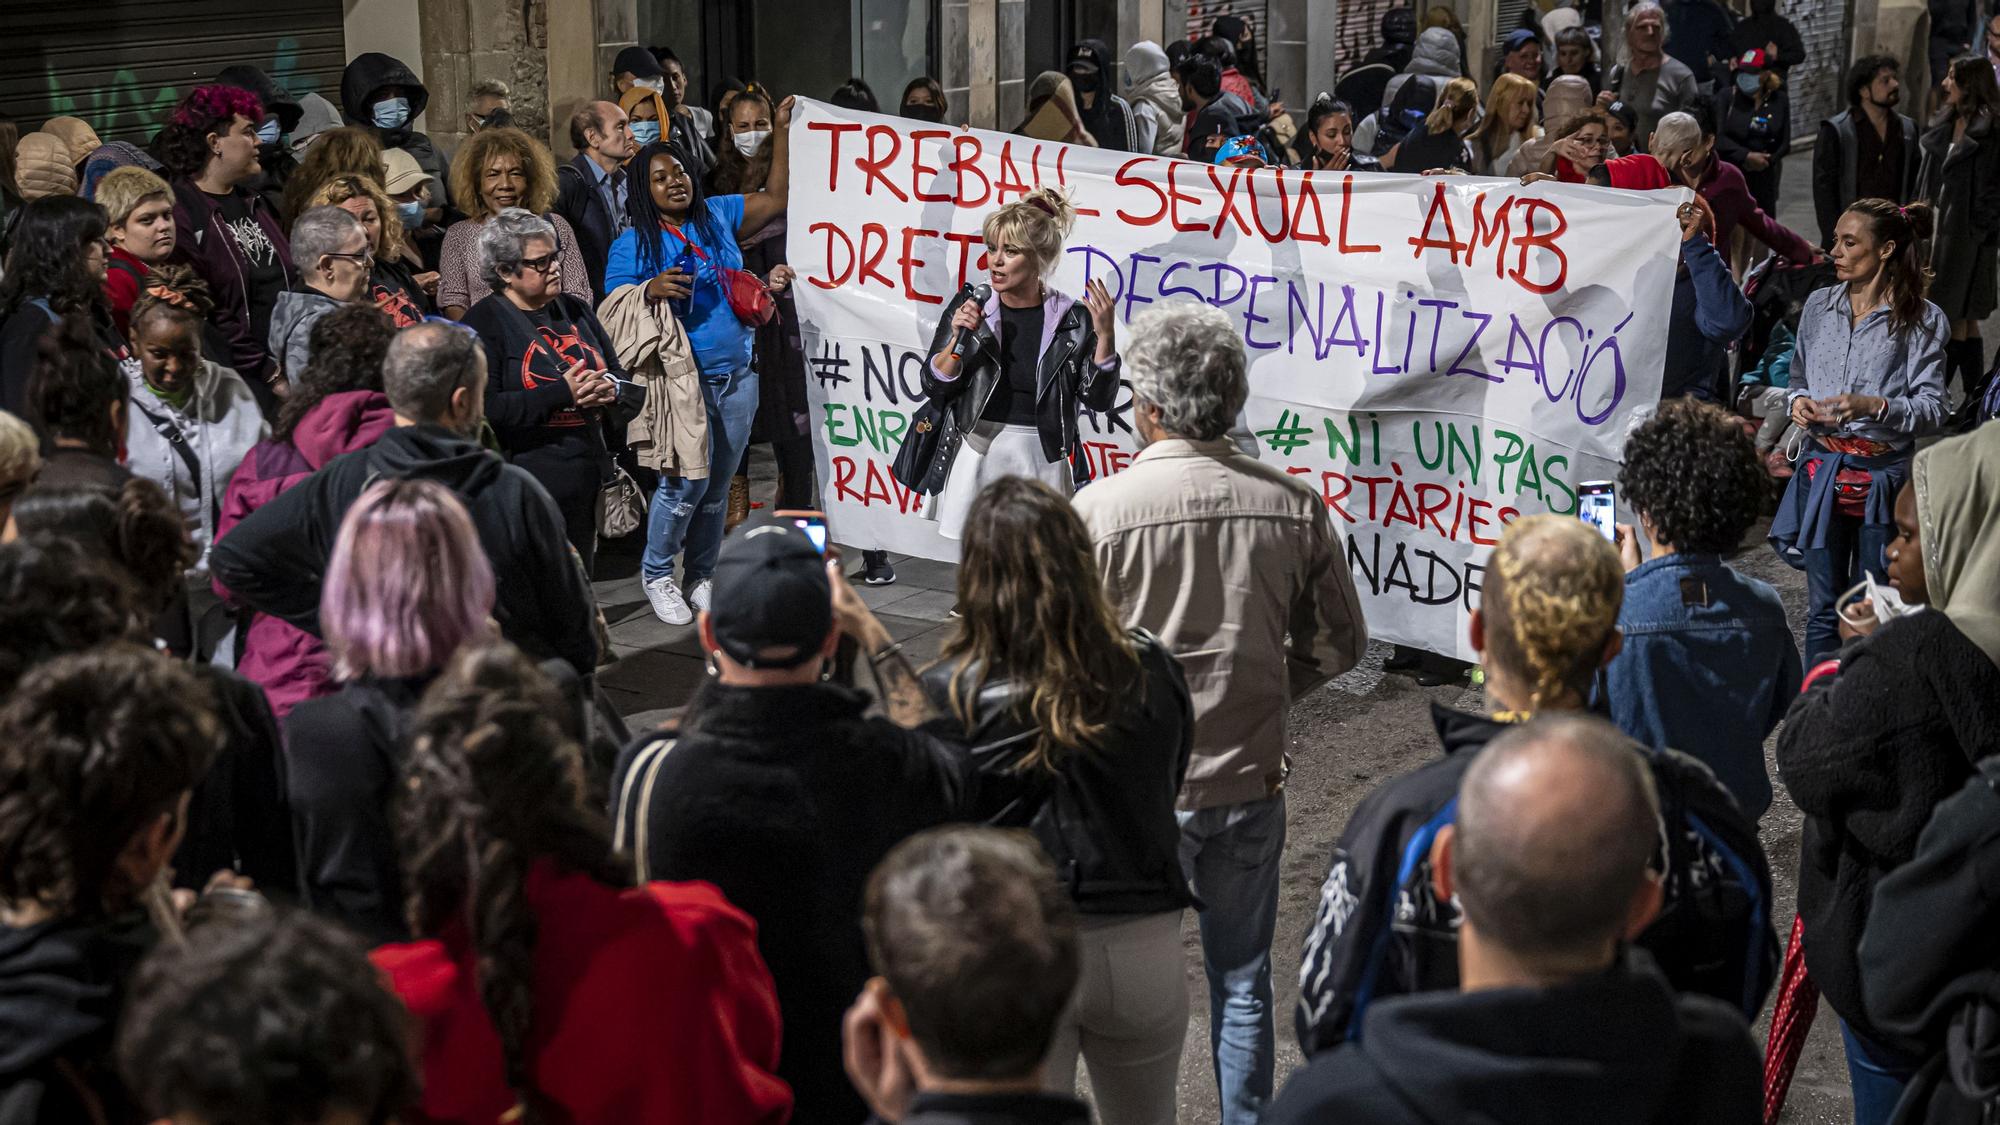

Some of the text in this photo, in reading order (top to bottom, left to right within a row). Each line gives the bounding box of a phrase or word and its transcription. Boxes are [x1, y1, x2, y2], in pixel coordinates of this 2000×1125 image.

[808, 221, 988, 304] DRET
[1115, 156, 1381, 254] SEXUAL
[1408, 182, 1568, 294] AMB
[823, 402, 913, 454] ENR
